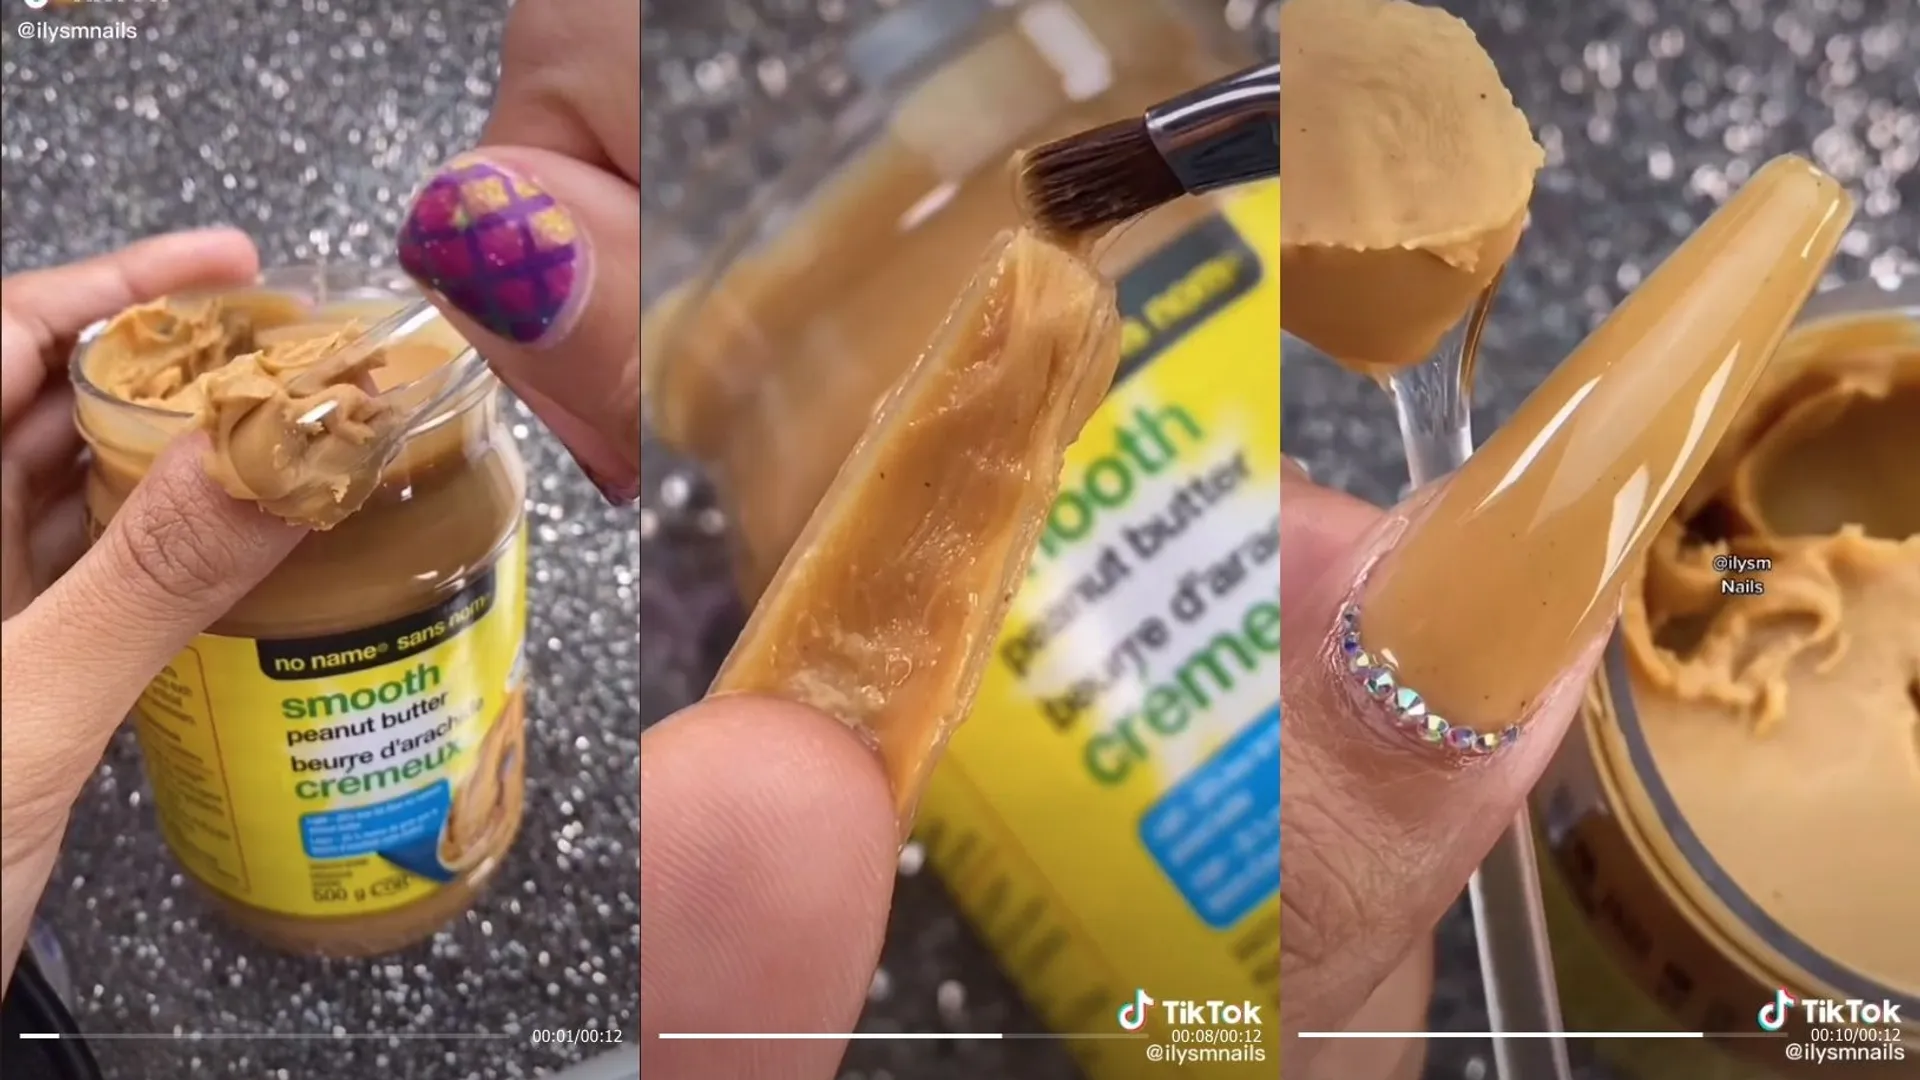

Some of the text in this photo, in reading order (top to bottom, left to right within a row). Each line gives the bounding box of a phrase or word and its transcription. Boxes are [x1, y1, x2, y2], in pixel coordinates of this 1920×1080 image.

[274, 656, 305, 672] no
[396, 620, 446, 651] sans
[281, 663, 442, 721] smooth
[286, 692, 449, 747] peanut butter
[291, 750, 374, 773] beurre
[313, 887, 348, 903] 500
